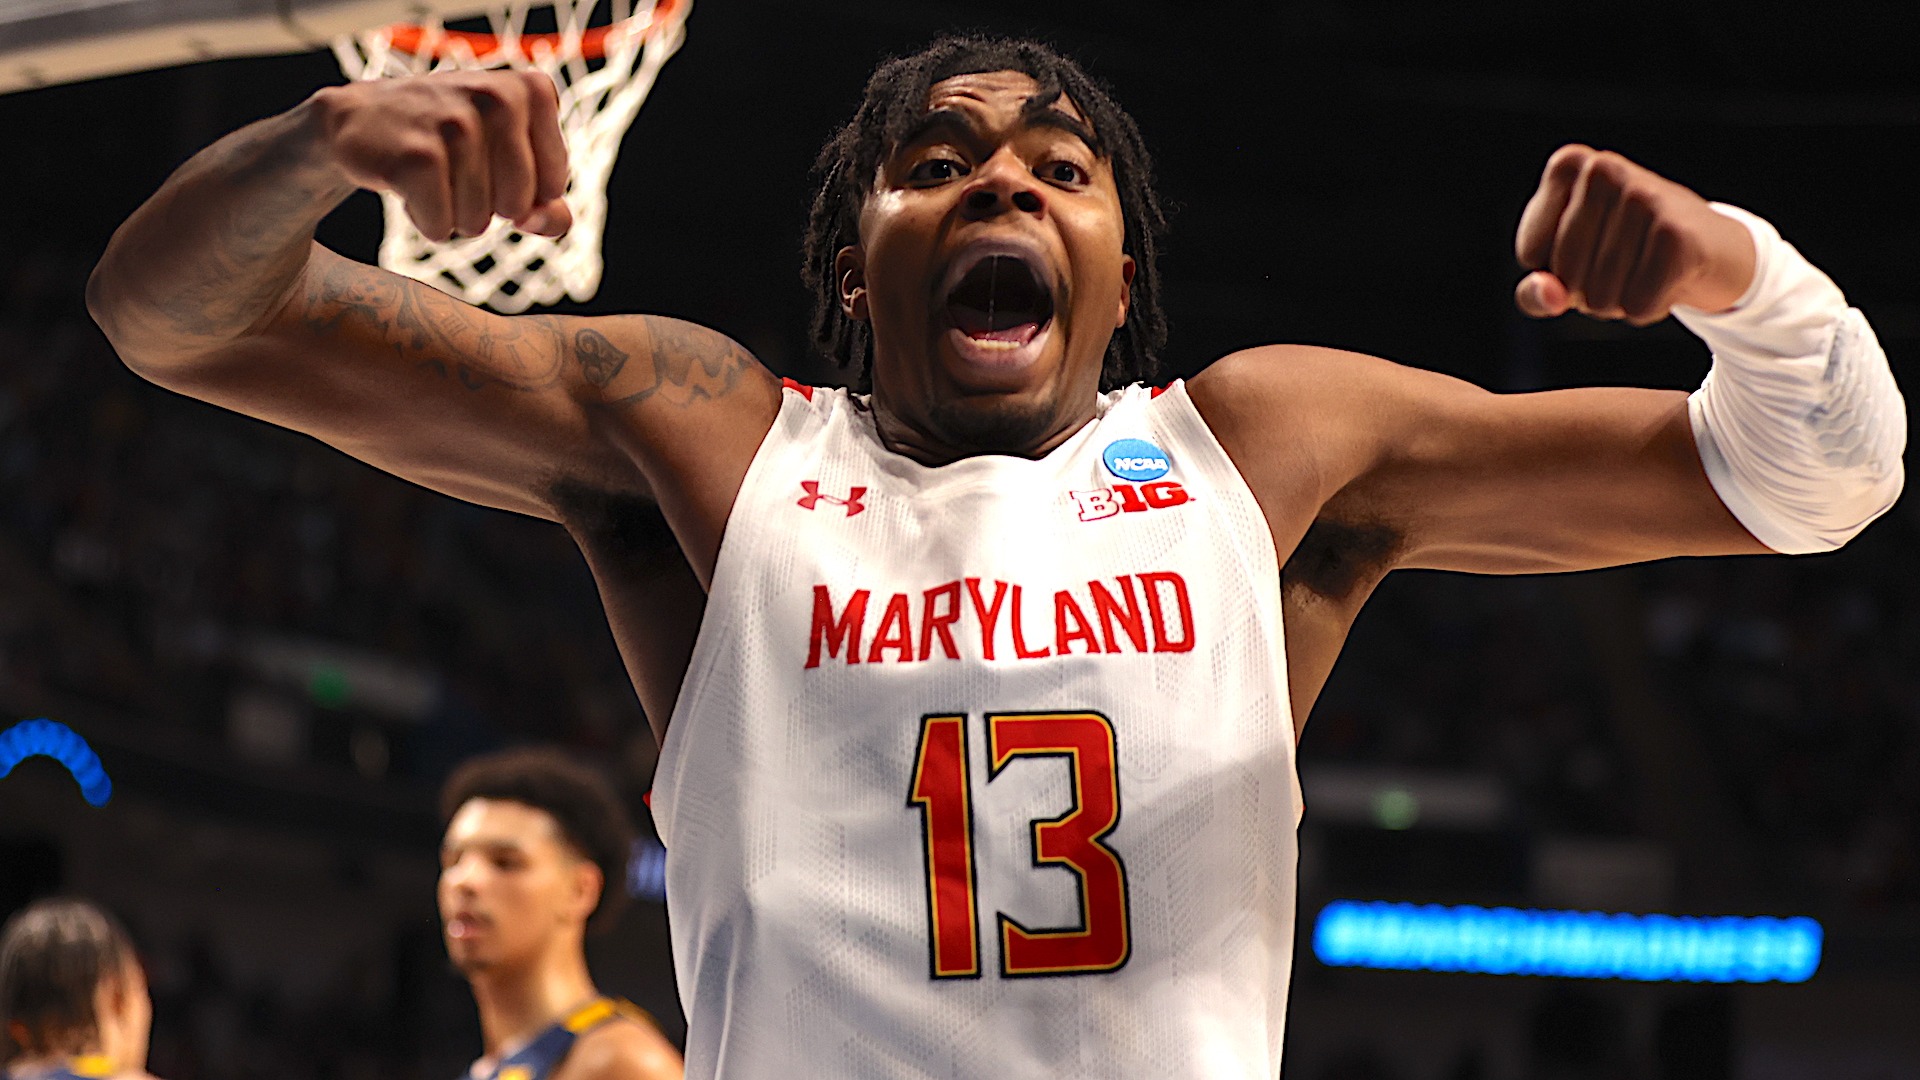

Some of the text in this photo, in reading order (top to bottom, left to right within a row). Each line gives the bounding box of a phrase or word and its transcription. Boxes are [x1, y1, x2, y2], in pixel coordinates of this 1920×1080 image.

[1113, 457, 1169, 471] NCAA
[805, 570, 1197, 669] MARYLAND
[905, 709, 1133, 981] 13
